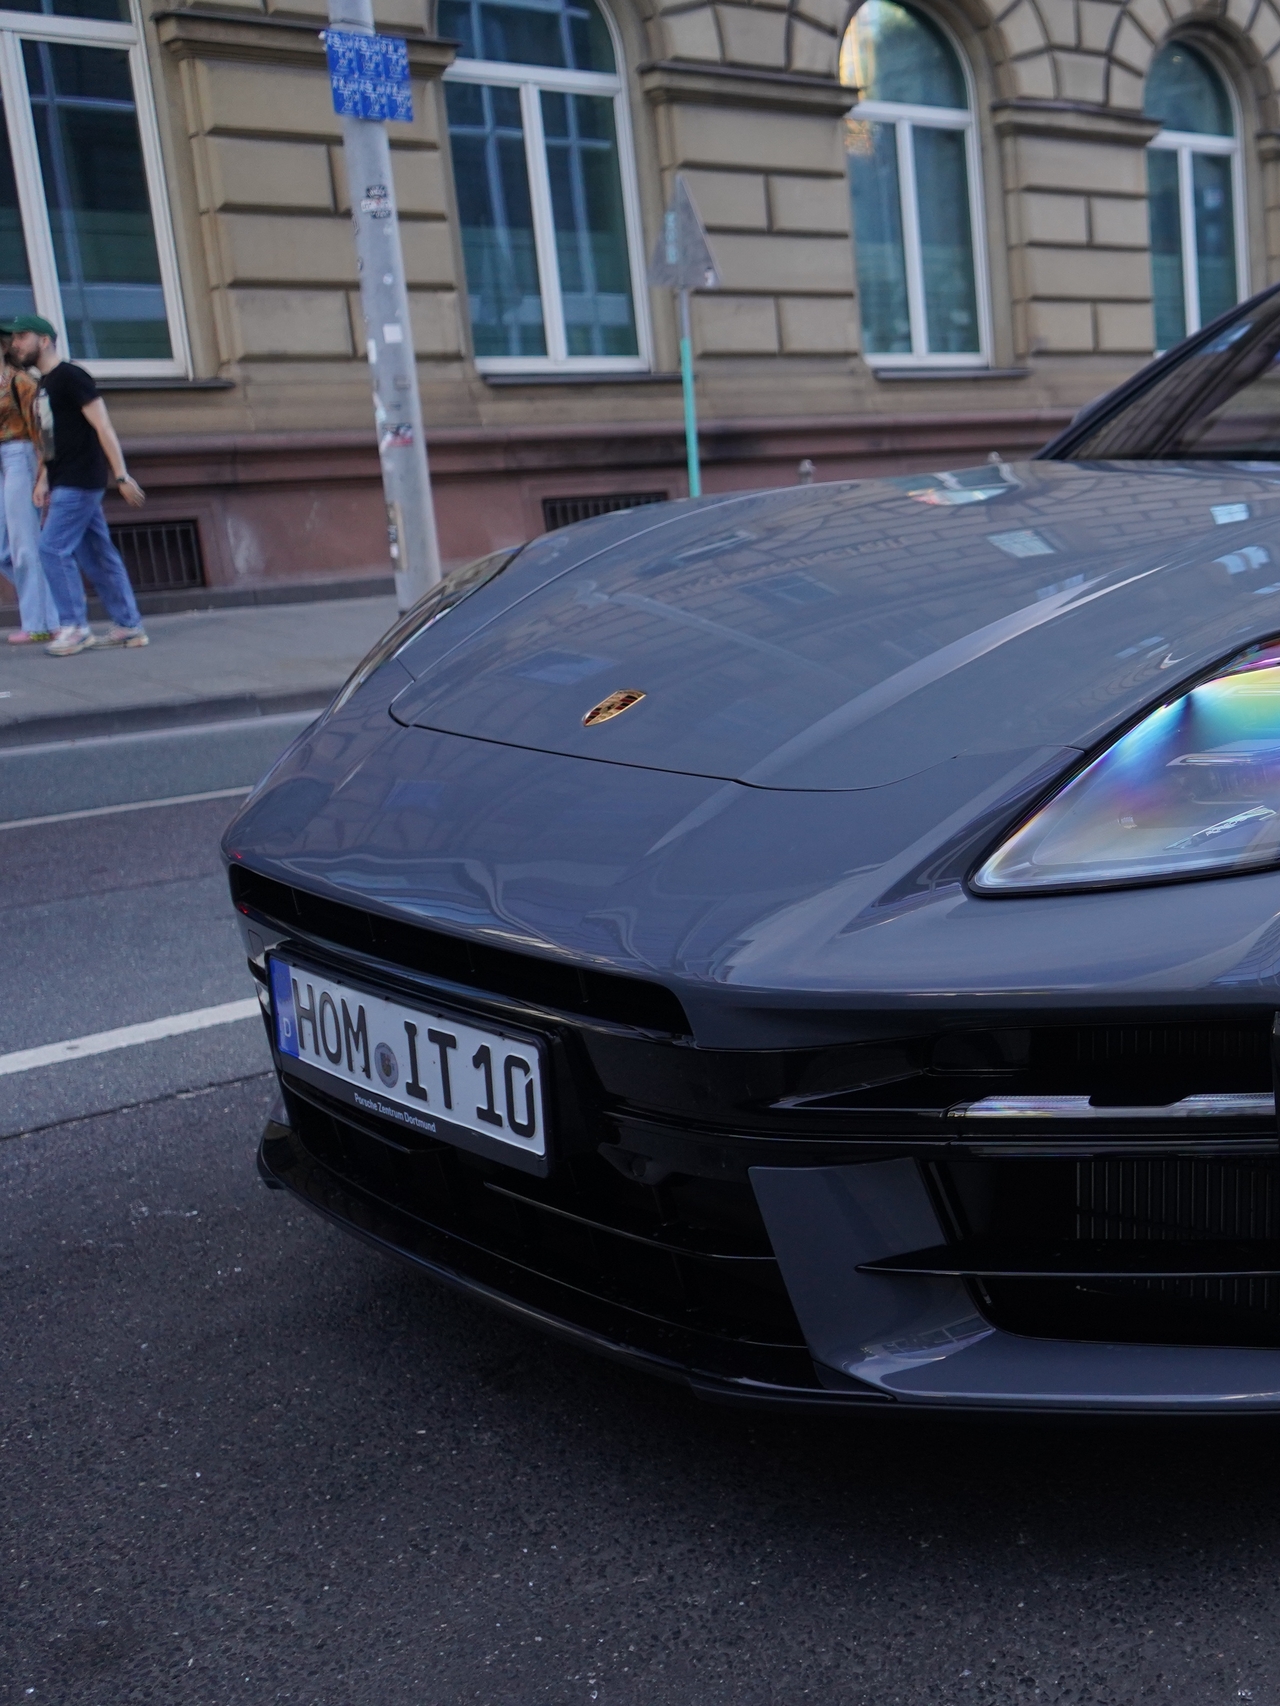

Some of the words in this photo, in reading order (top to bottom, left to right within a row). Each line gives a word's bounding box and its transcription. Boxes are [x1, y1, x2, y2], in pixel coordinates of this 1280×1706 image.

[282, 1016, 292, 1038] D
[291, 976, 373, 1080] HOM
[403, 1019, 457, 1110] IT
[472, 1043, 536, 1138] 10
[354, 1092, 378, 1111] Porsche
[377, 1102, 405, 1121] Zentrum
[403, 1111, 437, 1133] Dortmund
